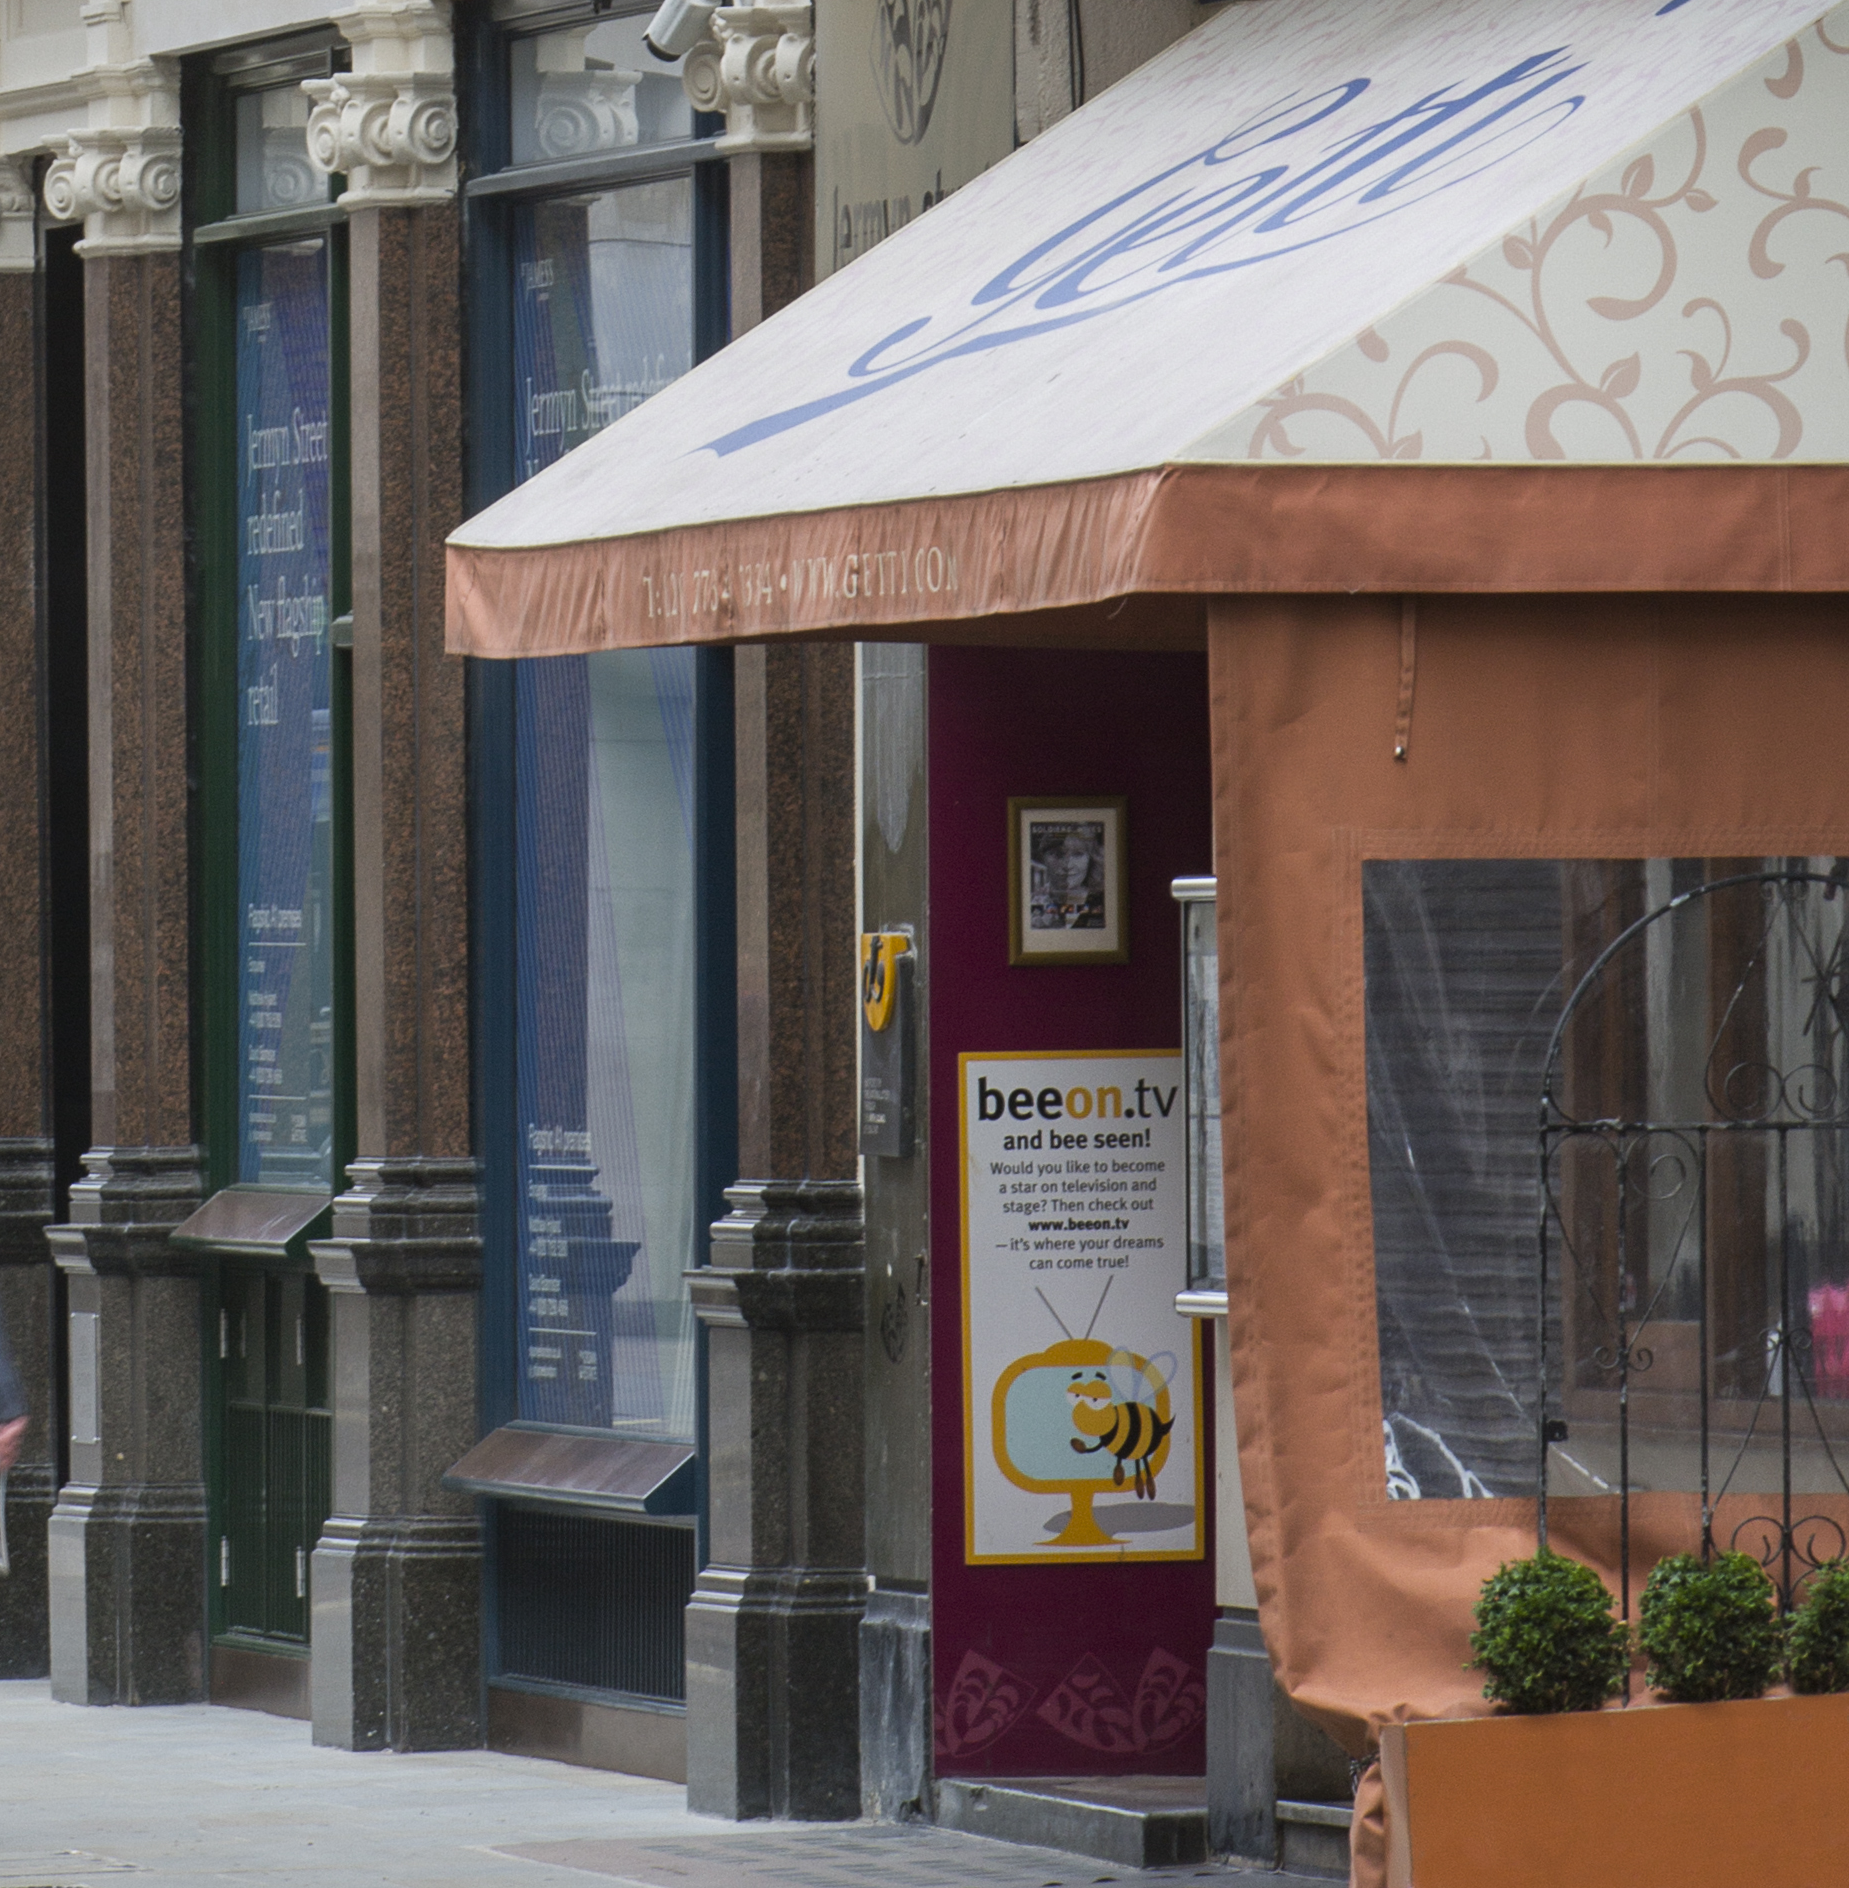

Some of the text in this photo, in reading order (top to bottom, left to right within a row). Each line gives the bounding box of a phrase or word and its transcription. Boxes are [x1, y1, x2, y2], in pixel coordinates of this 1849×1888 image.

[526, 376, 578, 456] Jermyn
[247, 405, 328, 488] Jermyn Street
[247, 488, 305, 556] redefined
[247, 575, 325, 658] New flagship
[247, 662, 279, 726] retail
[978, 1076, 1178, 1121] beeon.tv
[1003, 1128, 1151, 1150] and bee seen!
[990, 1159, 1165, 1177] Would you like to become
[999, 1177, 1157, 1194] a star on television and
[1003, 1198, 1154, 1215] stage? Then check out
[1028, 1218, 1130, 1231] www.beeon.tv
[1034, 1236, 1076, 1250] where
[1079, 1237, 1109, 1252] your
[1113, 1235, 1165, 1249] dreams
[1029, 1255, 1129, 1270] can come true!
